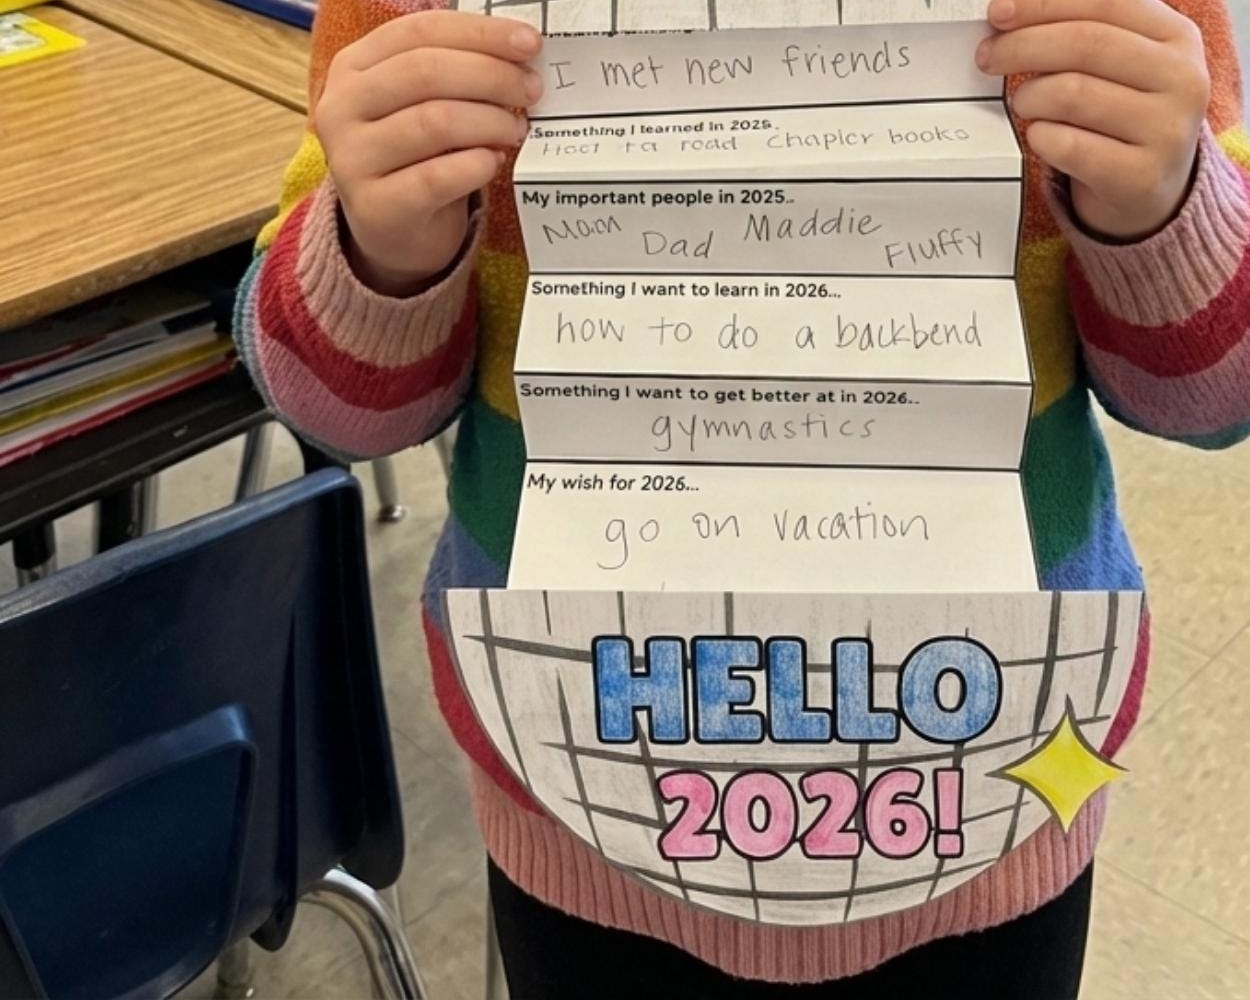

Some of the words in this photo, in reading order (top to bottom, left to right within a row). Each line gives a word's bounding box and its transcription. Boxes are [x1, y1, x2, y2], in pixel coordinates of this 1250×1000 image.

[550, 60, 576, 90] I
[600, 55, 664, 89] met
[684, 55, 753, 86] new
[781, 41, 911, 79] friends
[522, 190, 551, 209] My
[555, 189, 645, 207] important
[651, 189, 713, 207] people
[718, 189, 734, 204] in
[642, 230, 715, 260] Dad
[743, 206, 883, 243] Maddie
[884, 227, 983, 269] Fluffy
[531, 280, 626, 300] Something
[631, 281, 637, 296] I
[641, 281, 685, 297] want
[692, 281, 710, 297] to
[714, 281, 758, 299] learn
[764, 283, 780, 298] in
[556, 311, 625, 344] how
[648, 316, 693, 346] to
[718, 312, 759, 350] do
[795, 325, 816, 350] a
[834, 310, 983, 352] backbend
[520, 382, 620, 400] Something
[636, 386, 683, 400] want
[689, 387, 709, 401] to
[714, 387, 747, 404] get
[752, 388, 811, 403] better
[816, 390, 836, 404] at
[841, 389, 858, 404] in
[651, 413, 876, 453] gymnastics
[526, 473, 556, 495] My
[561, 473, 604, 491] wish
[608, 474, 636, 491] for
[596, 517, 661, 571] go
[691, 511, 741, 540] on
[591, 635, 1003, 745] HELLO
[657, 767, 965, 861] 2026!
